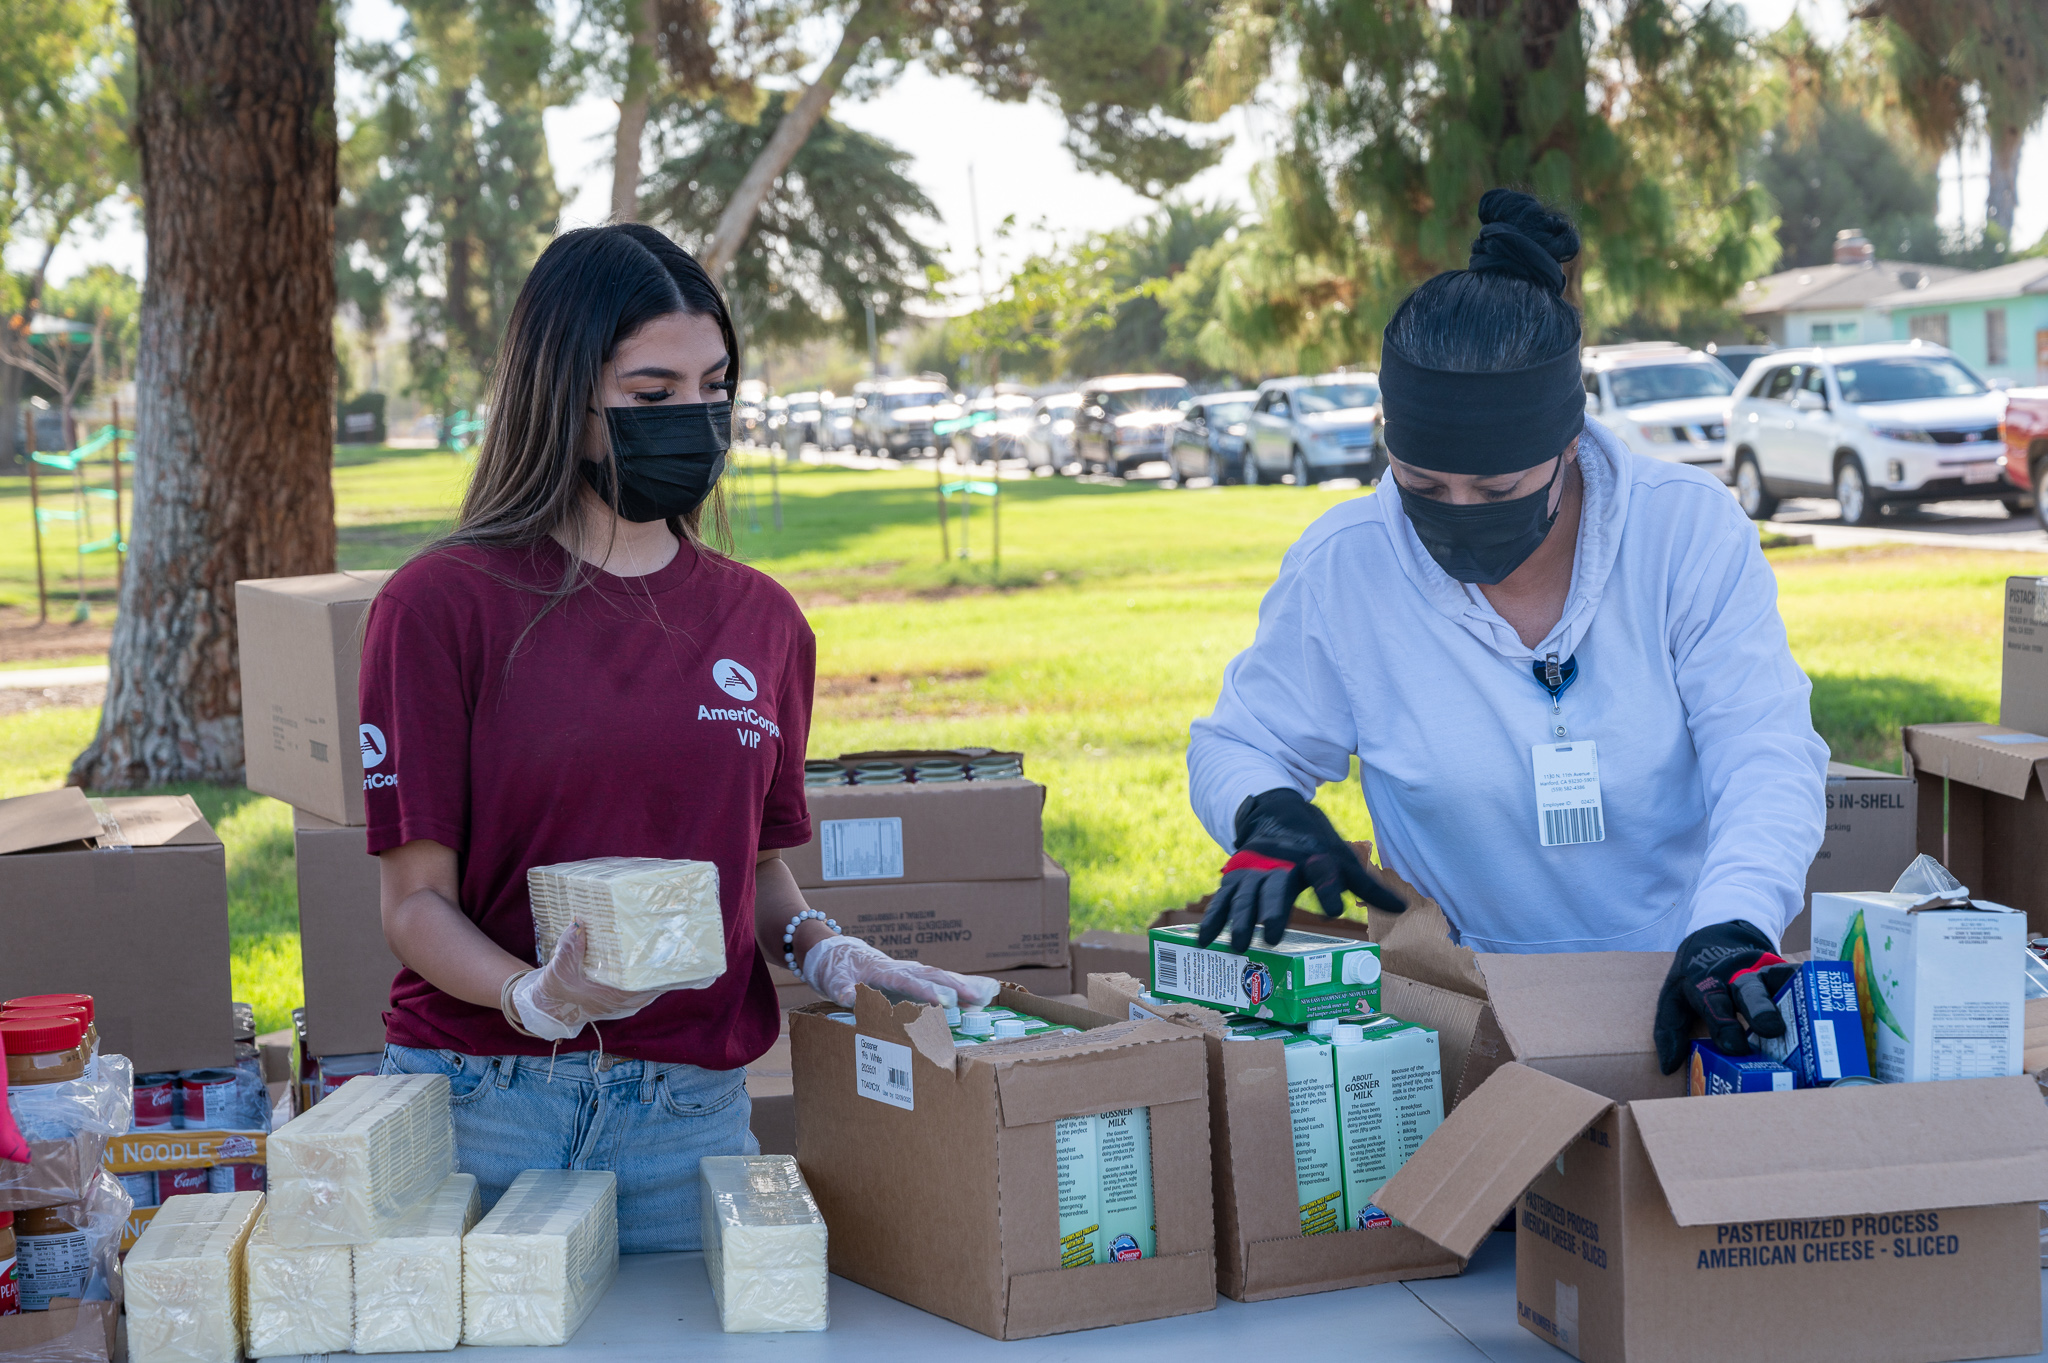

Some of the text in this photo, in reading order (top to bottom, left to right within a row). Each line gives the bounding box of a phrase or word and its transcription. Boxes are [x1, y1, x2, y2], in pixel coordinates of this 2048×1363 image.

[2010, 589, 2035, 605] PISTACH
[698, 705, 779, 737] AmeriCorps
[737, 728, 760, 748] VIP
[1840, 794, 1904, 809] IN-SHELL
[1826, 824, 1851, 832] acking
[879, 934, 911, 946] PINK
[915, 930, 972, 943] CANNED
[894, 948, 919, 959] ARCTIC
[1817, 971, 1832, 1011] MACARONI
[1829, 971, 1844, 999] CHEESE
[1843, 982, 1858, 1011] DINNER
[861, 1039, 878, 1051] Gossner
[870, 1053, 882, 1064] White
[1352, 1073, 1373, 1082] ABOUT
[1408, 1071, 1430, 1080] packaging
[1345, 1080, 1380, 1092] GOSSNER
[1354, 1090, 1373, 1100] MILK
[1100, 1108, 1133, 1119] GOSSNER
[1108, 1117, 1126, 1128] MILK
[123, 1142, 211, 1164] NOODLE
[1300, 1177, 1330, 1185] Preparedness
[1525, 1191, 1599, 1243] PASTEURIZED PROCESS
[1368, 1220, 1390, 1228] Gossner
[1717, 1212, 1939, 1244] PASTEURIZED PROCESS
[1522, 1209, 1551, 1240] AMERICAN
[1551, 1226, 1576, 1255] CHEESE
[1582, 1241, 1607, 1270] SLICED
[1119, 1251, 1140, 1260] Gossner
[1697, 1244, 1796, 1269] AMERICAN
[1803, 1240, 1874, 1263] CHEESE
[1894, 1235, 1959, 1258] SLICED
[1518, 1300, 1531, 1320] PLANT
